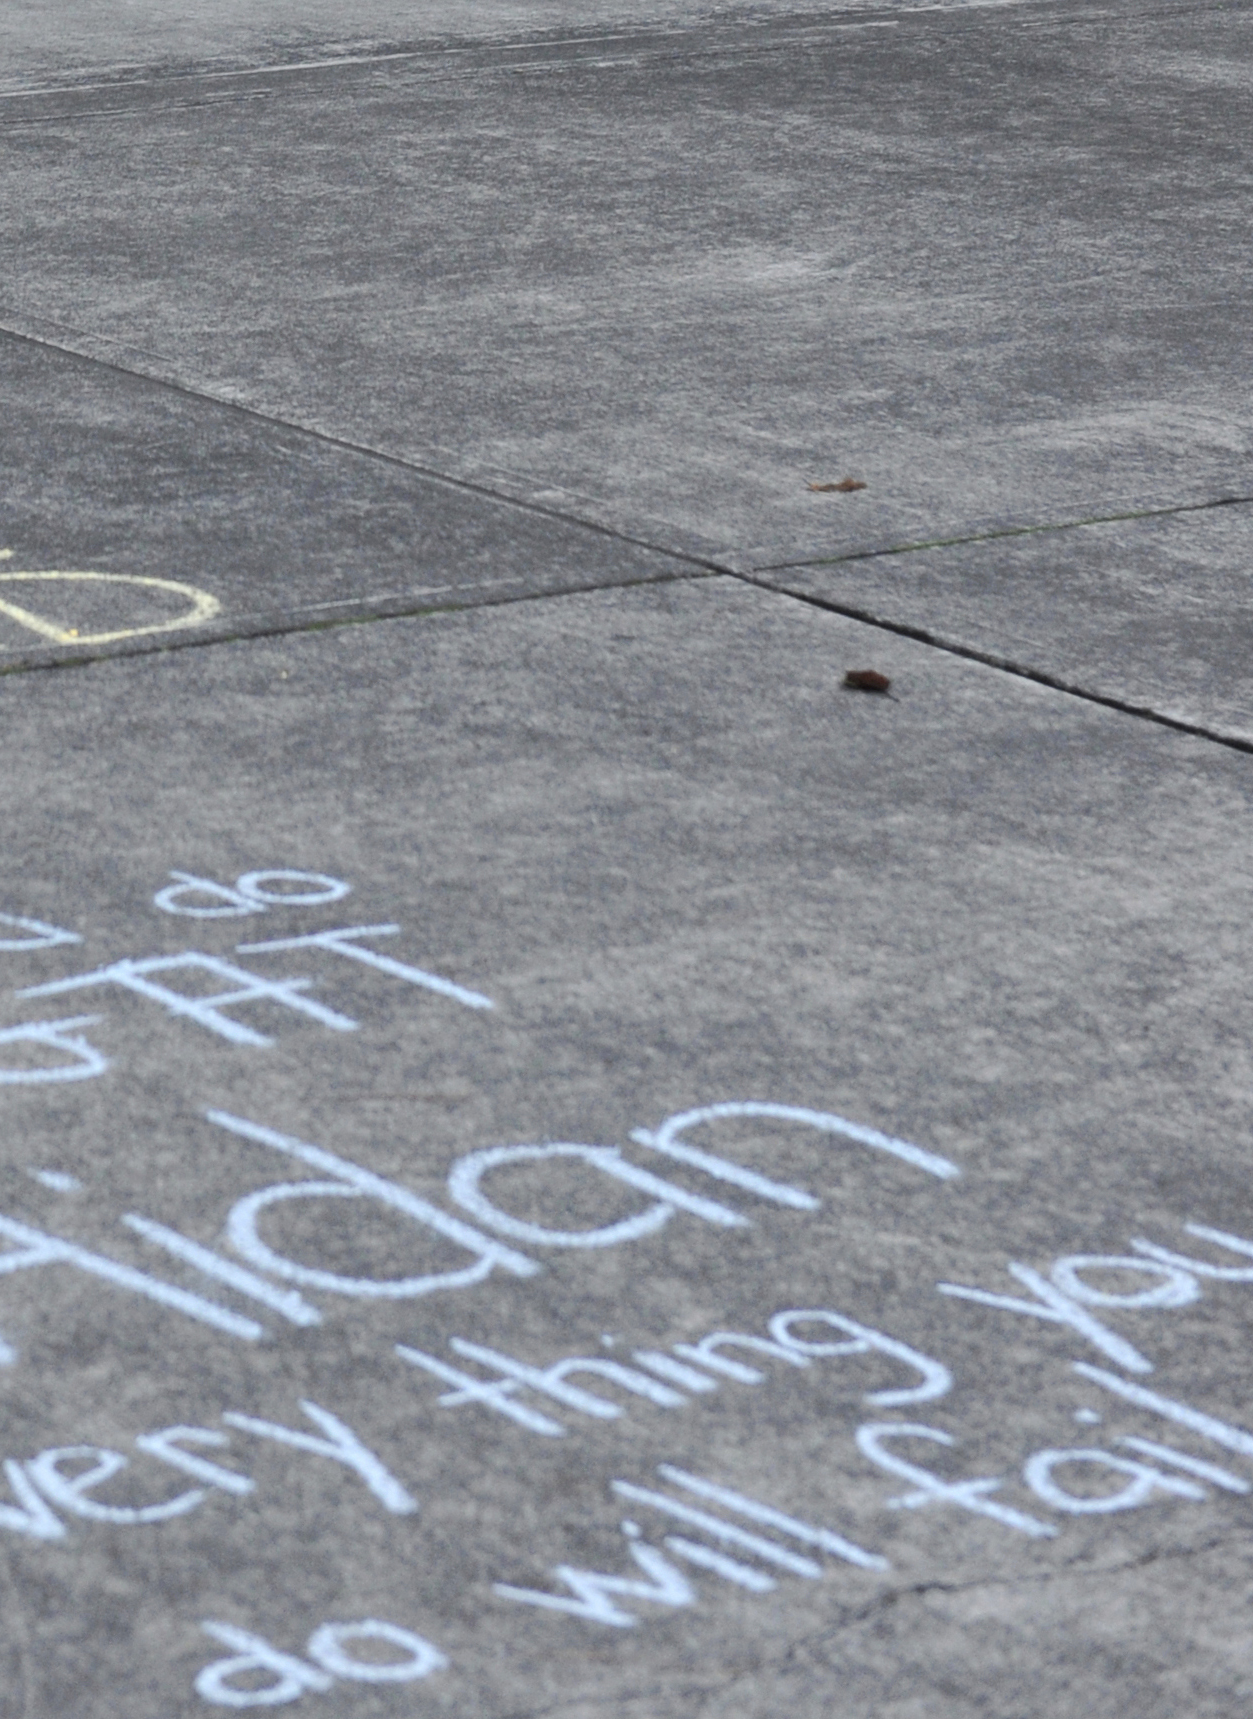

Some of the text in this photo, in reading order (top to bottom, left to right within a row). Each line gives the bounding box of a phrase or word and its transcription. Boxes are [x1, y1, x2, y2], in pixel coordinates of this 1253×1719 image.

[152, 869, 350, 920] do
[195, 1360, 1253, 1710] do will fail
